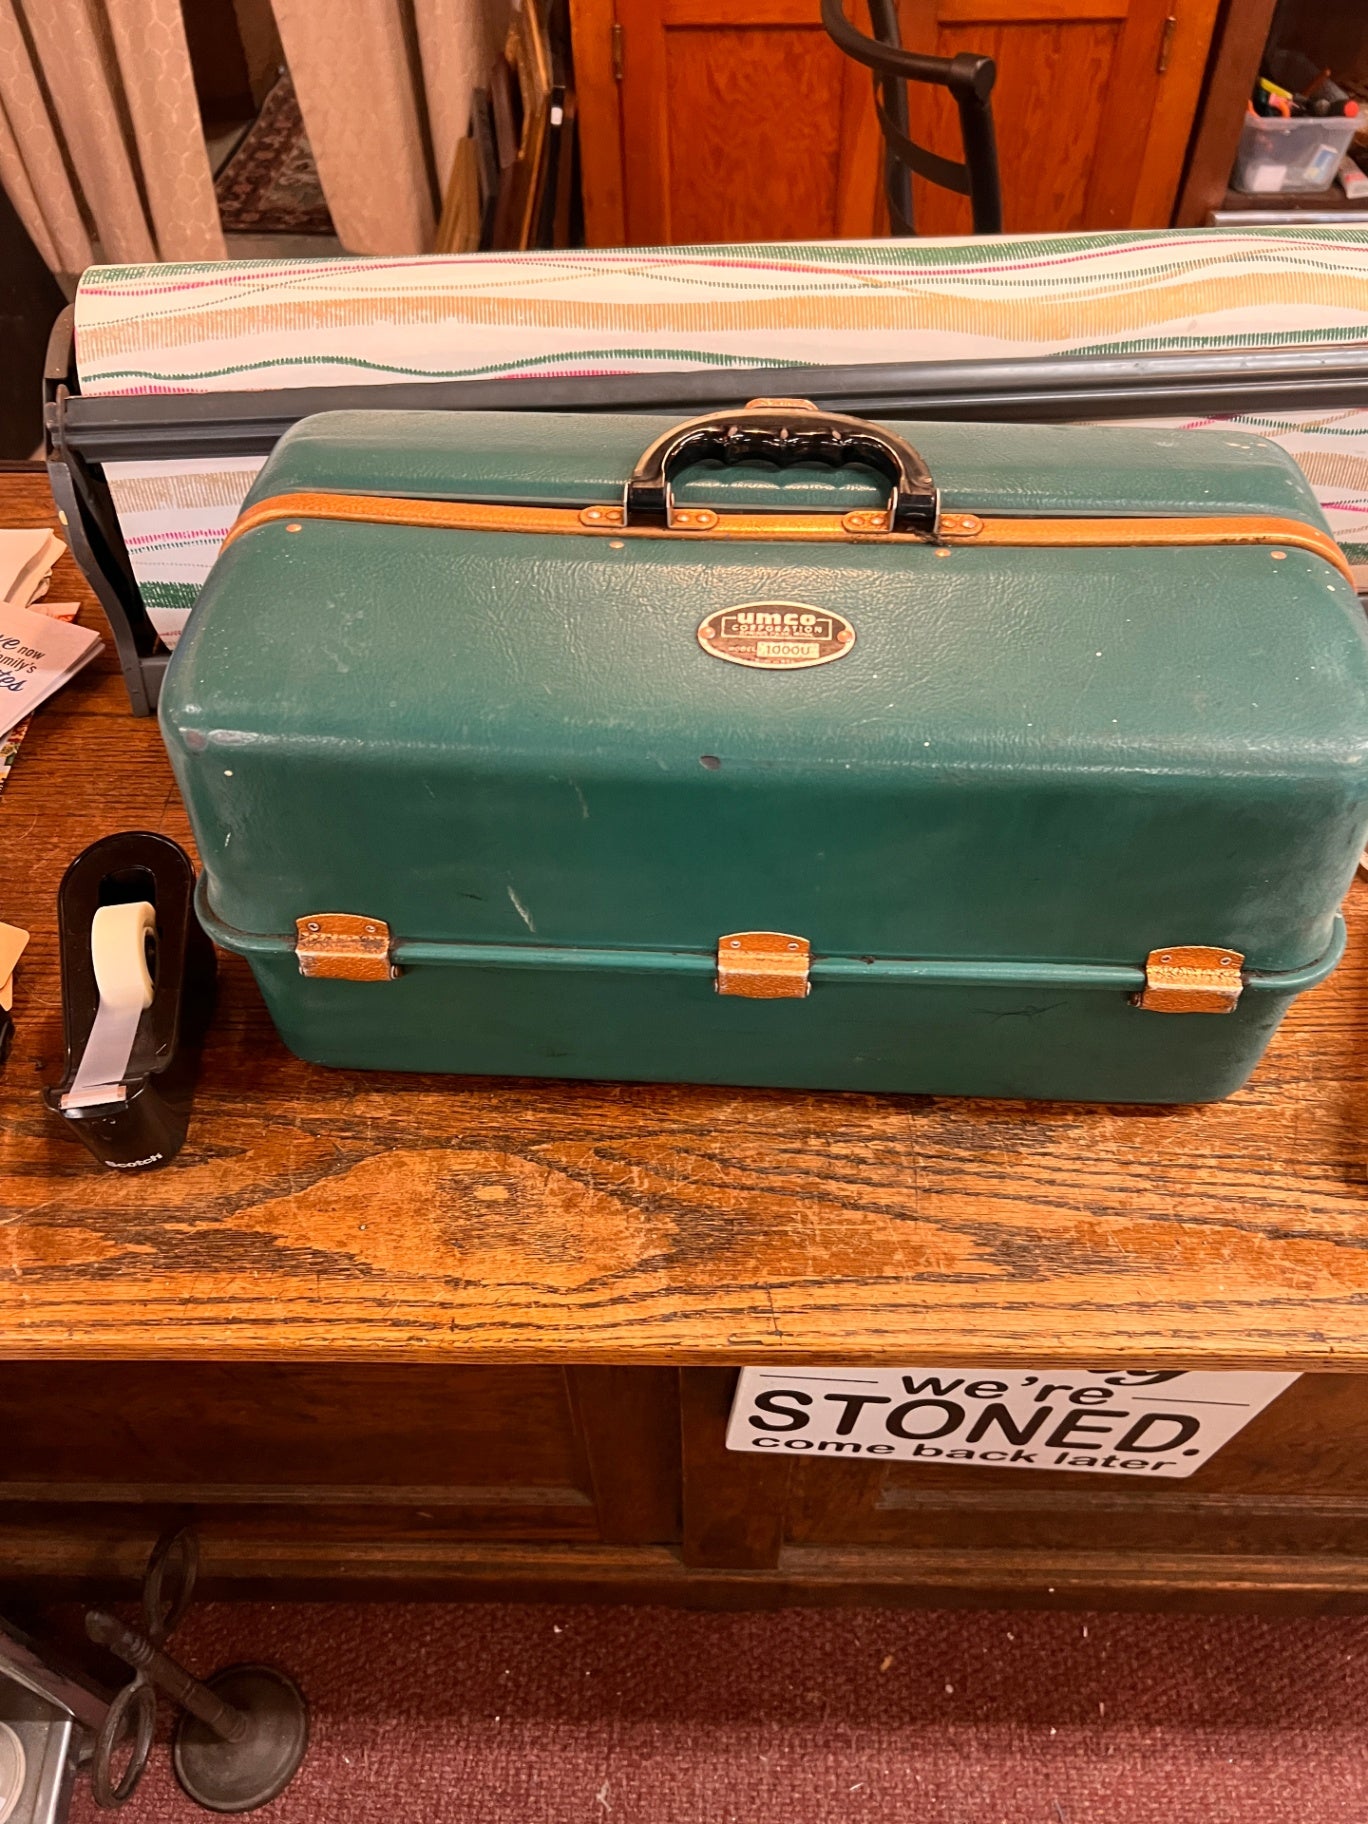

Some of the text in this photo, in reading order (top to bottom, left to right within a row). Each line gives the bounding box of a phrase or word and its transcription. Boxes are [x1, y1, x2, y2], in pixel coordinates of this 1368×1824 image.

[731, 624, 823, 634] CORPORATION
[17, 646, 46, 660] now
[766, 645, 810, 655] 1000U
[104, 1152, 163, 1168] Scotch
[902, 1375, 1115, 1405] we're
[748, 1389, 1201, 1456] STONED.
[752, 1437, 1178, 1471] come back later
